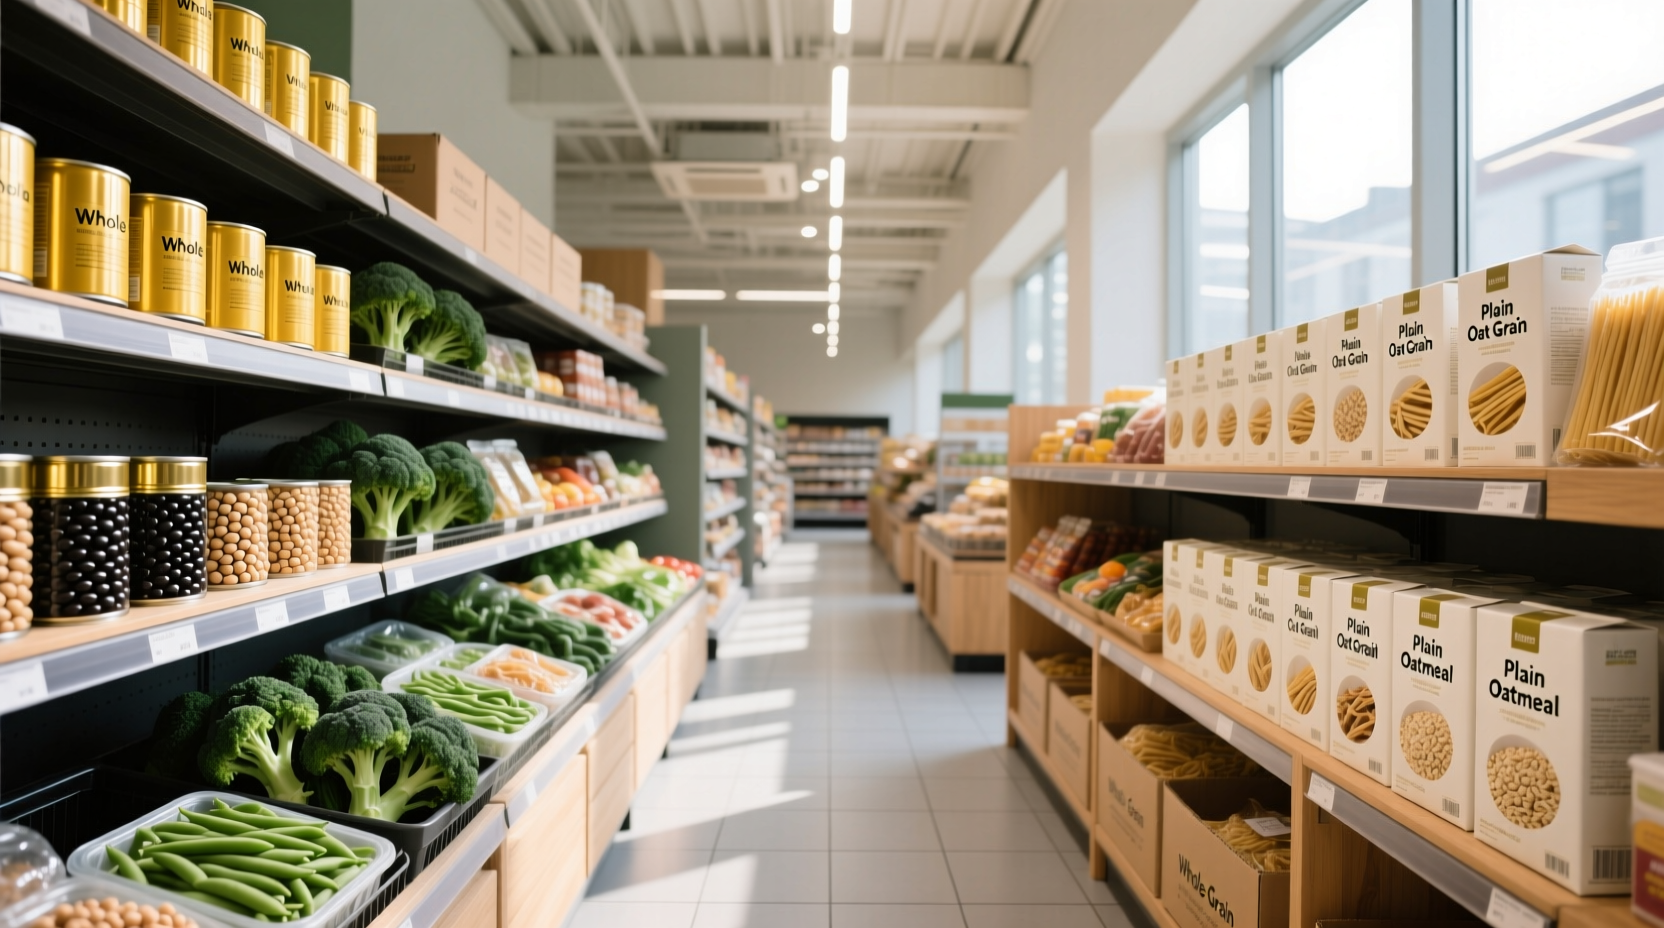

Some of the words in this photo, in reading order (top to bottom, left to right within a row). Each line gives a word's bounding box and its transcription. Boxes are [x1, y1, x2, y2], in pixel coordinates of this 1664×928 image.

[75, 208, 126, 232] Whole
[162, 236, 204, 257] Whole
[1482, 300, 1513, 320] Plain
[1468, 325, 1490, 341] Oat
[1348, 617, 1370, 637] Plain
[1337, 633, 1352, 650] Oat
[1413, 634, 1442, 658] Plain
[1401, 651, 1453, 683] Oatmeal
[1504, 658, 1545, 688] Plain
[1489, 679, 1559, 717] Oatmeal
[1178, 853, 1206, 898] Whole
[1208, 886, 1234, 928] Grain
